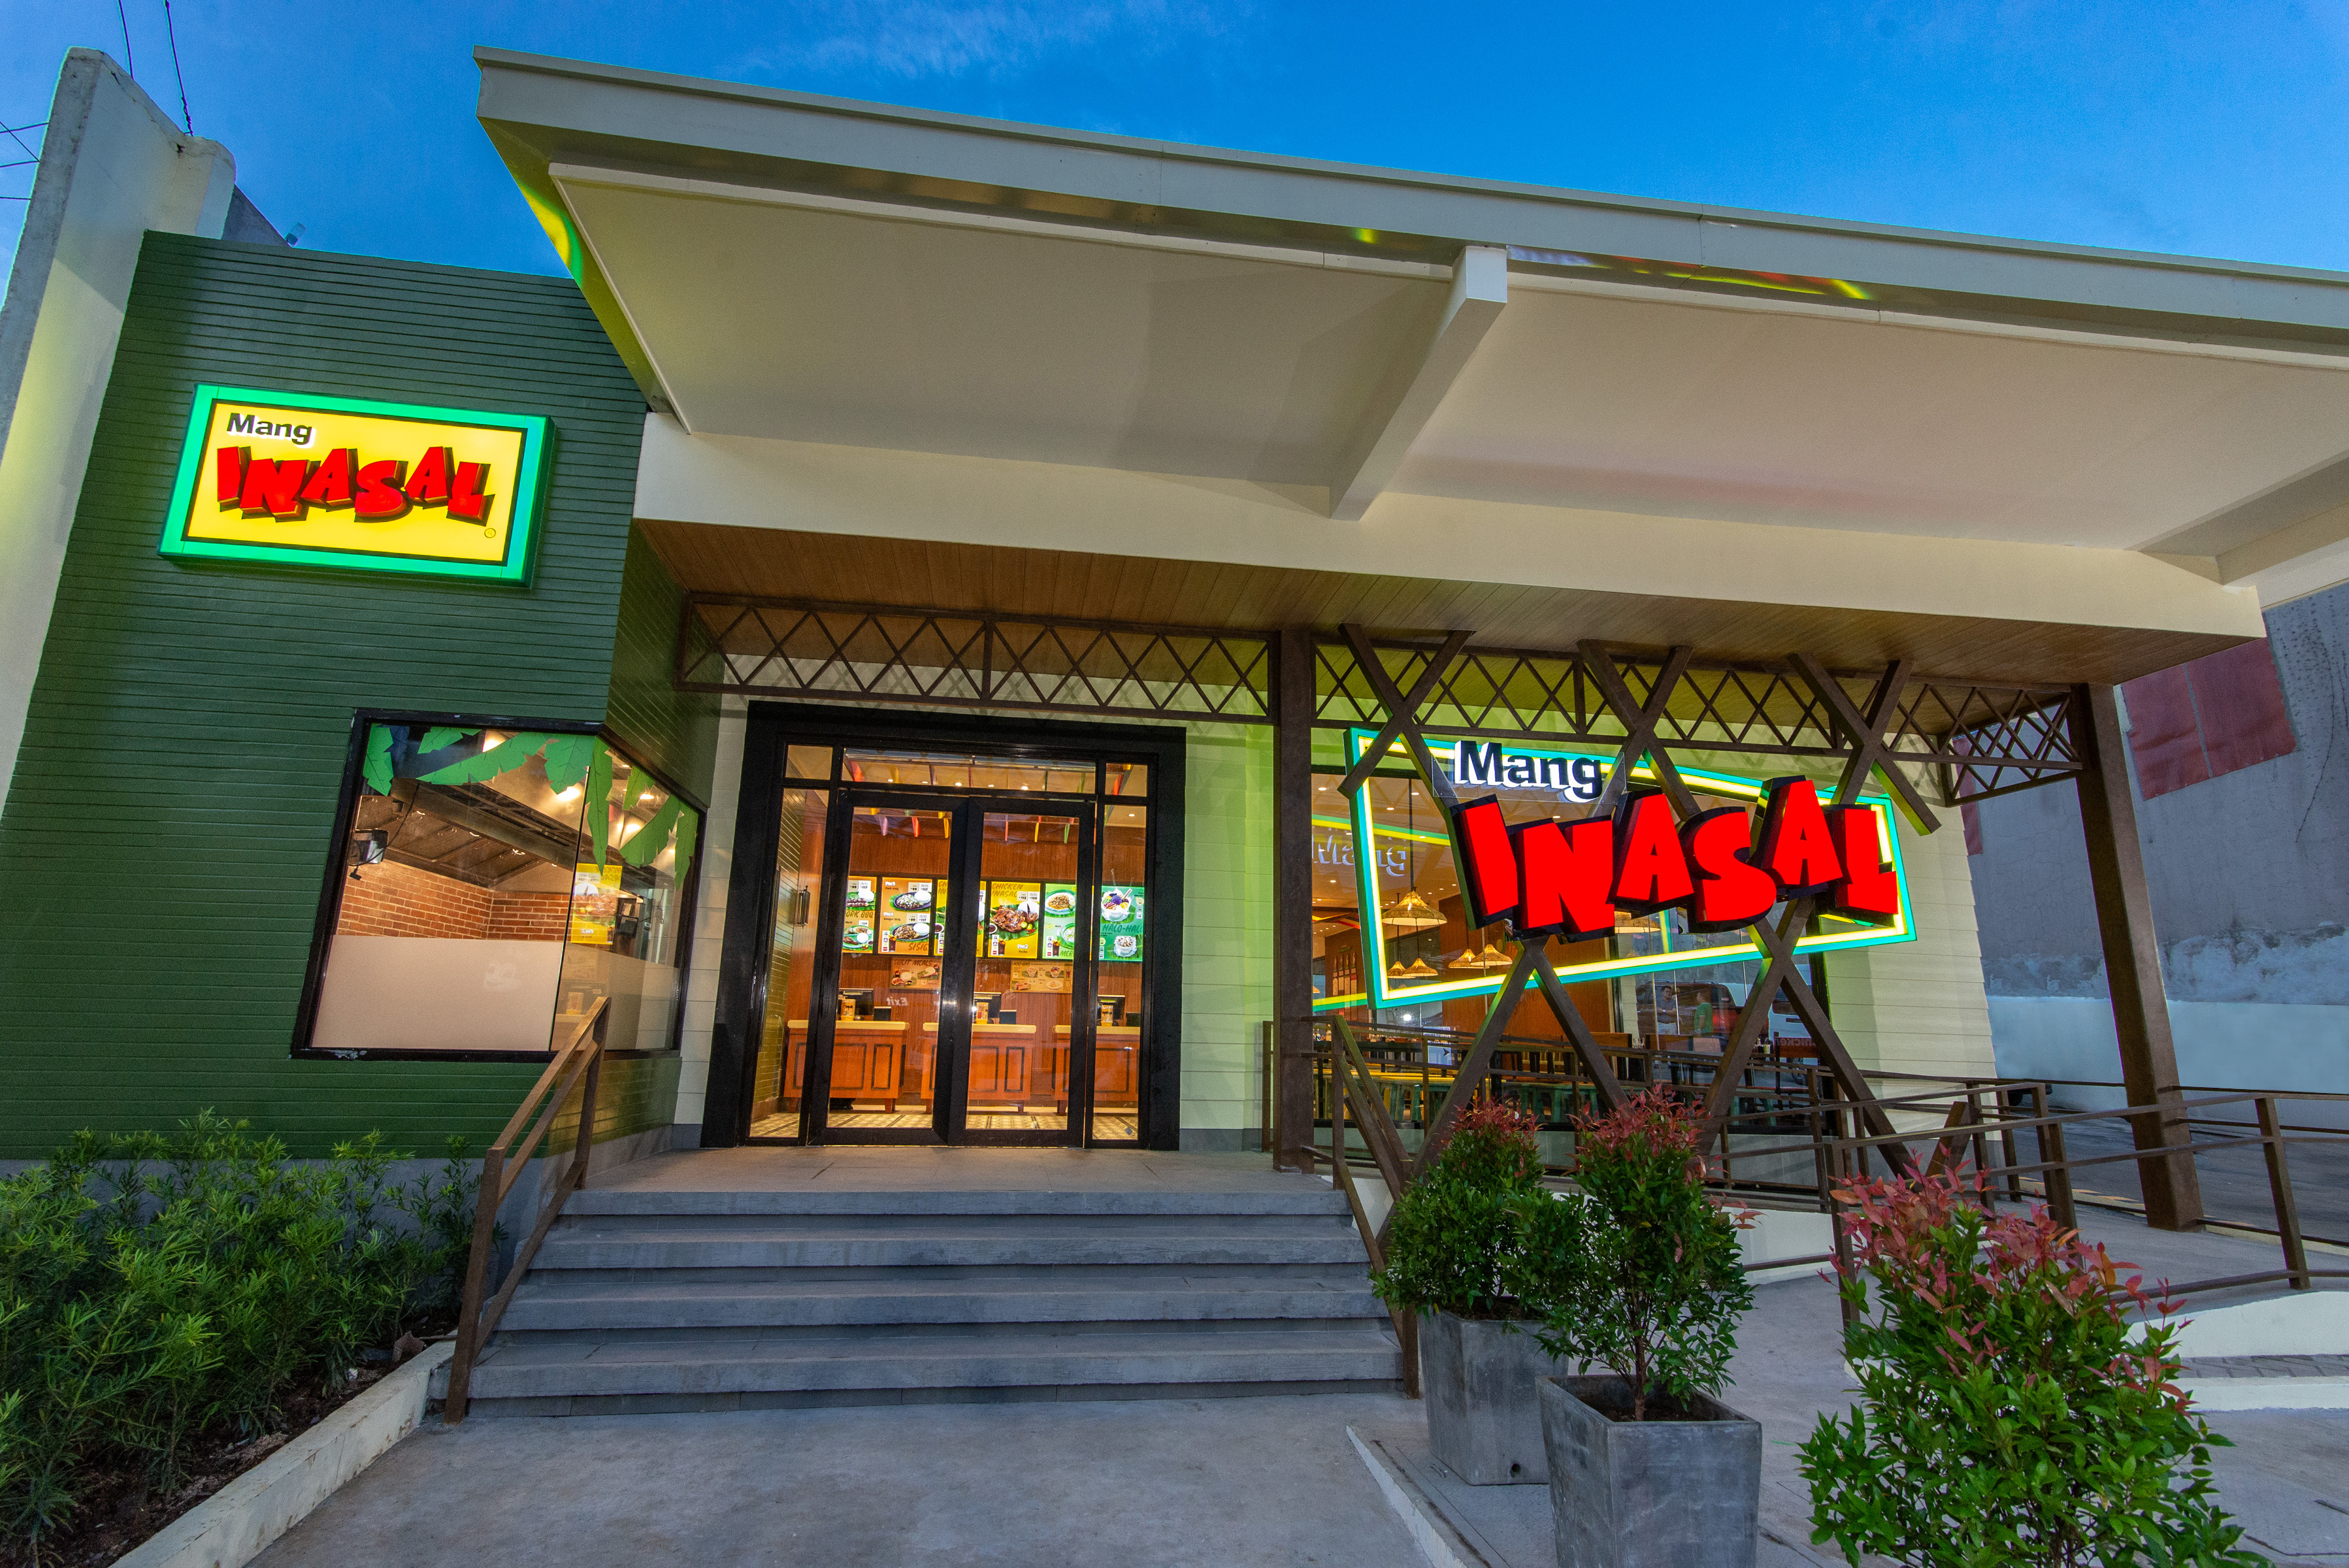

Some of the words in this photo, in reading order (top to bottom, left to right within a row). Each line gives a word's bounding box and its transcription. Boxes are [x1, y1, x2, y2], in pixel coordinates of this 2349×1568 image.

[227, 412, 314, 447] Mang
[217, 446, 493, 525] INASAL
[1456, 740, 1603, 801] Mang
[1451, 777, 1898, 939] INASAL
[908, 943, 928, 951] SISIG
